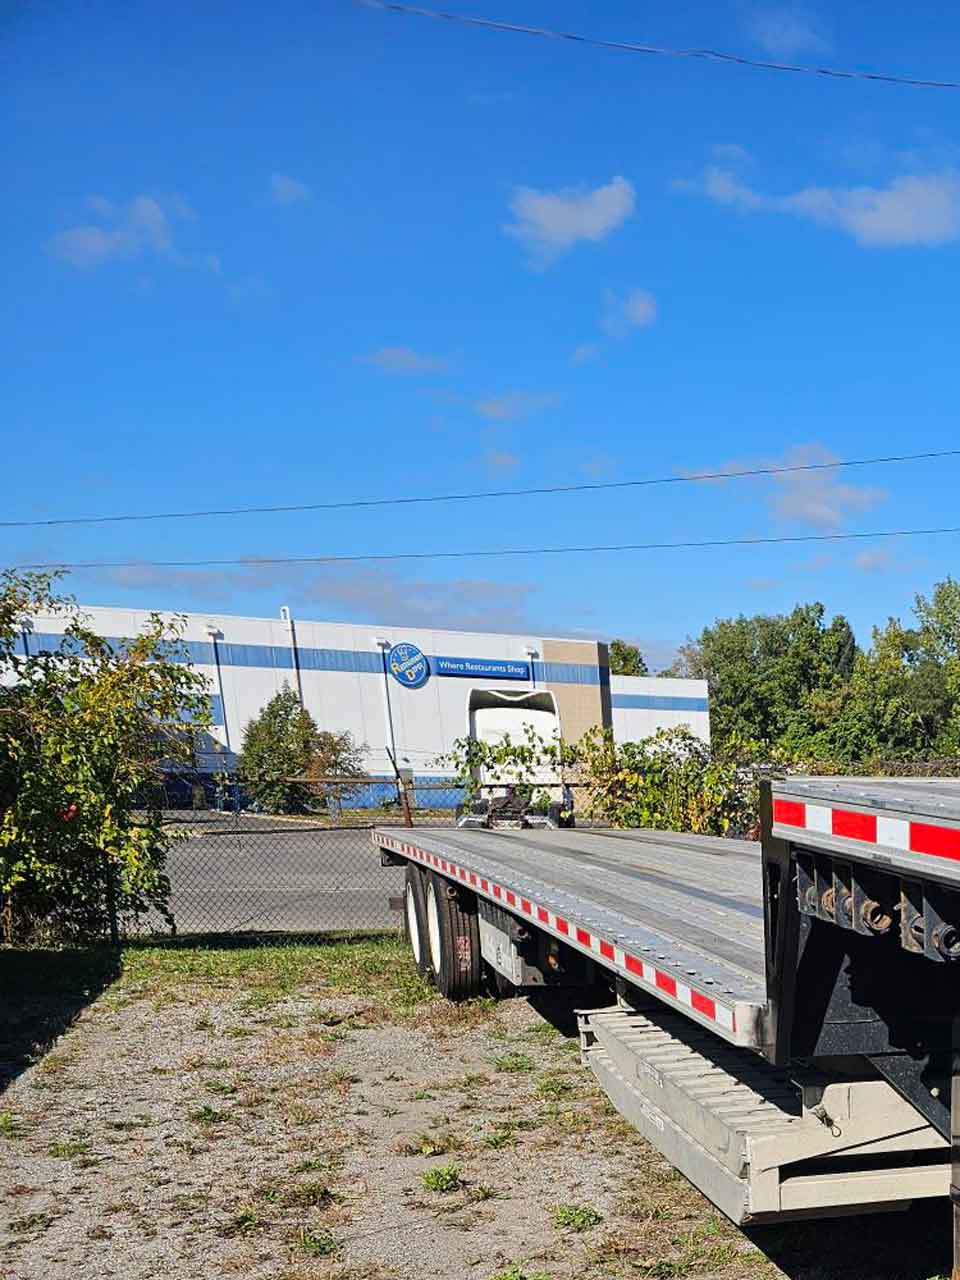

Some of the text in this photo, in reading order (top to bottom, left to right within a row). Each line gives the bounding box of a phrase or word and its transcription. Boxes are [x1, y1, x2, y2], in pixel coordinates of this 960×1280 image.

[439, 660, 525, 675] Where Restaurants Shop
